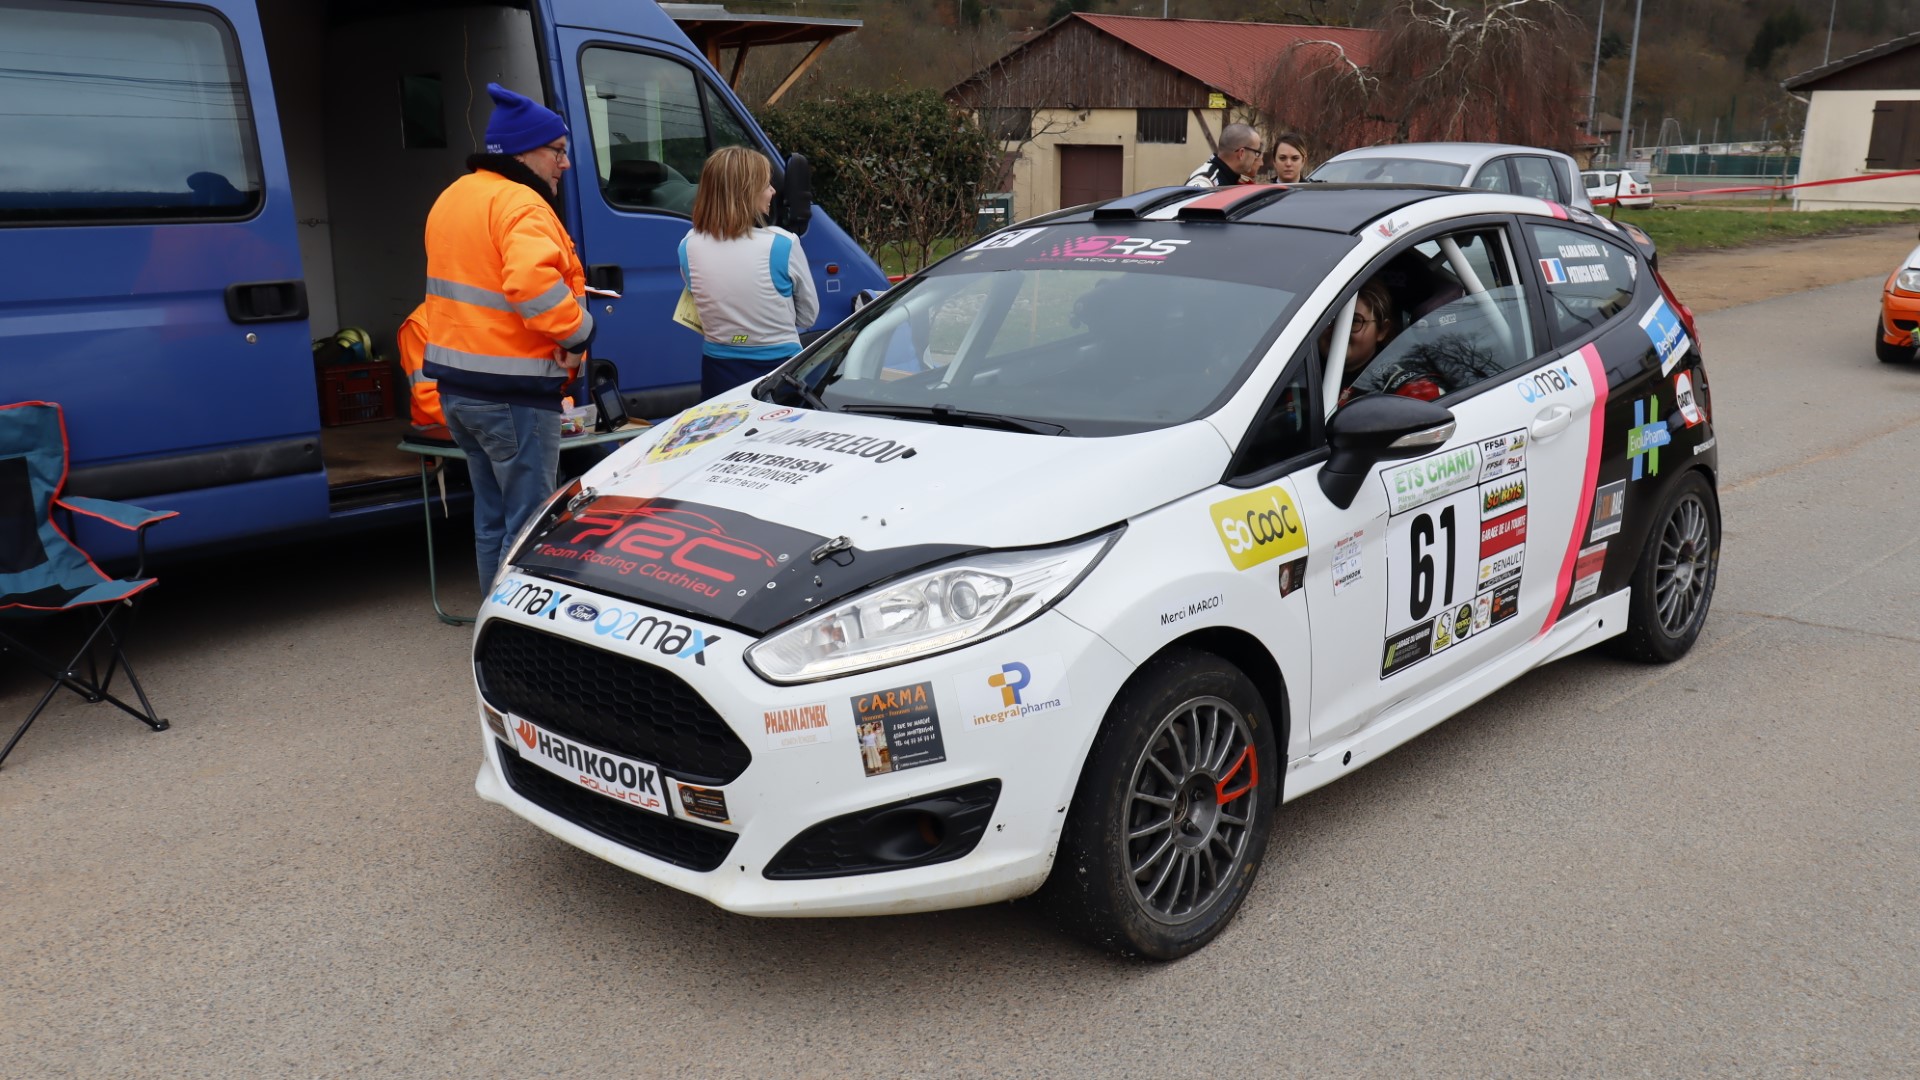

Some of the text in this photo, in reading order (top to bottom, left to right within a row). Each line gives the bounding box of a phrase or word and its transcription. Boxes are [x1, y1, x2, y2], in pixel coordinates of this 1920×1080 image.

[1485, 438, 1504, 451] FFSA
[720, 451, 834, 474] MONTBRISON
[720, 464, 749, 476] RUE
[748, 466, 809, 485] TUPINERIE
[1393, 448, 1475, 494] ETS CHANU
[537, 544, 720, 598] Team Racing Clathieu
[1410, 505, 1456, 621] 61
[1493, 551, 1523, 574] RENAULT
[1160, 607, 1186, 625] Merci
[1188, 596, 1218, 616] MARCO
[857, 684, 926, 713] CARMA
[764, 704, 828, 735] PHARMATHEK
[628, 793, 660, 809] CUP
